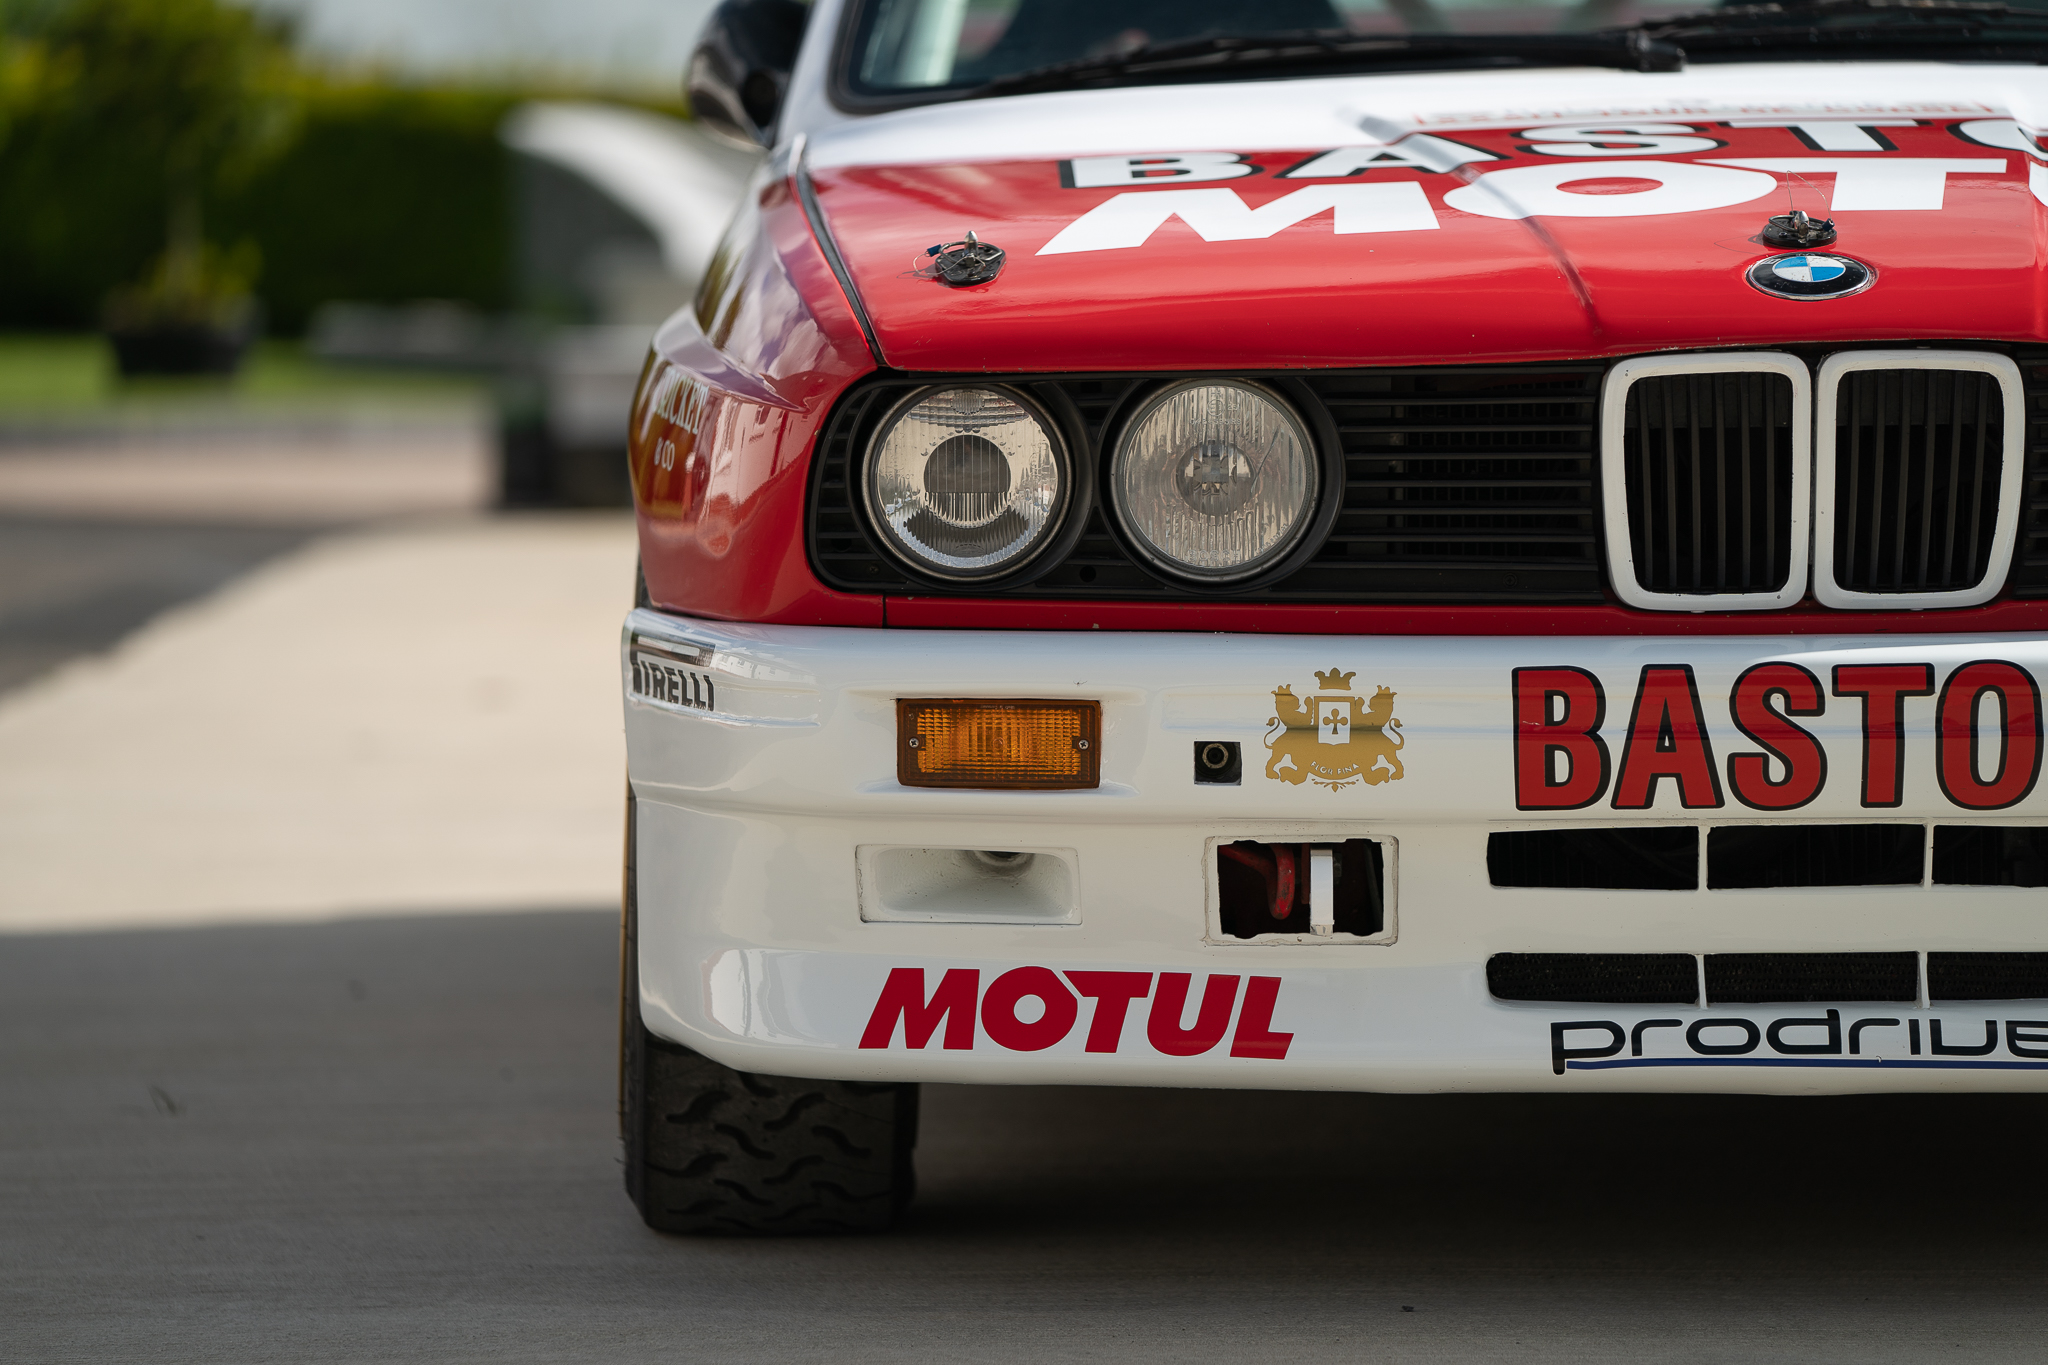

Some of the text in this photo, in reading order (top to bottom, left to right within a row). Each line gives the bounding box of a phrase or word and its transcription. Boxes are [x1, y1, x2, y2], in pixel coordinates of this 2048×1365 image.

[1034, 157, 2048, 256] MOT
[1310, 761, 1360, 776] FLOR FINA
[1512, 659, 2045, 811] BASTO
[858, 966, 1295, 1060] MOTUL
